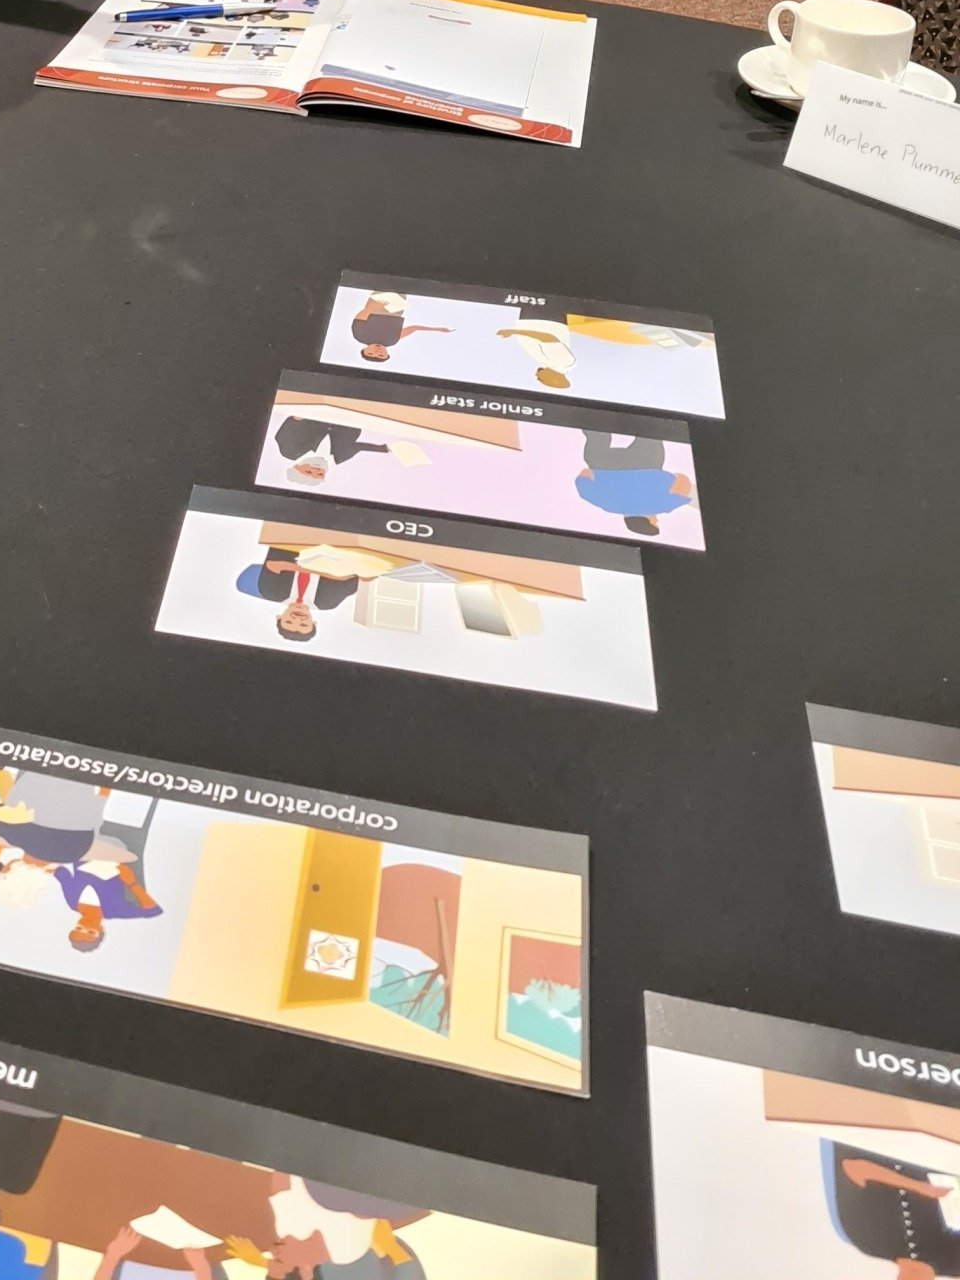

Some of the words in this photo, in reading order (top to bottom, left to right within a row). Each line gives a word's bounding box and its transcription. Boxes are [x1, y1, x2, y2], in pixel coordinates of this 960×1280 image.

[839, 94, 851, 104] My
[852, 97, 874, 107] name
[823, 123, 888, 159] Marlene
[503, 294, 546, 306] staff
[429, 394, 476, 407] staff
[480, 401, 543, 417] senior
[385, 520, 434, 537] CEO
[244, 787, 398, 831] corporation
